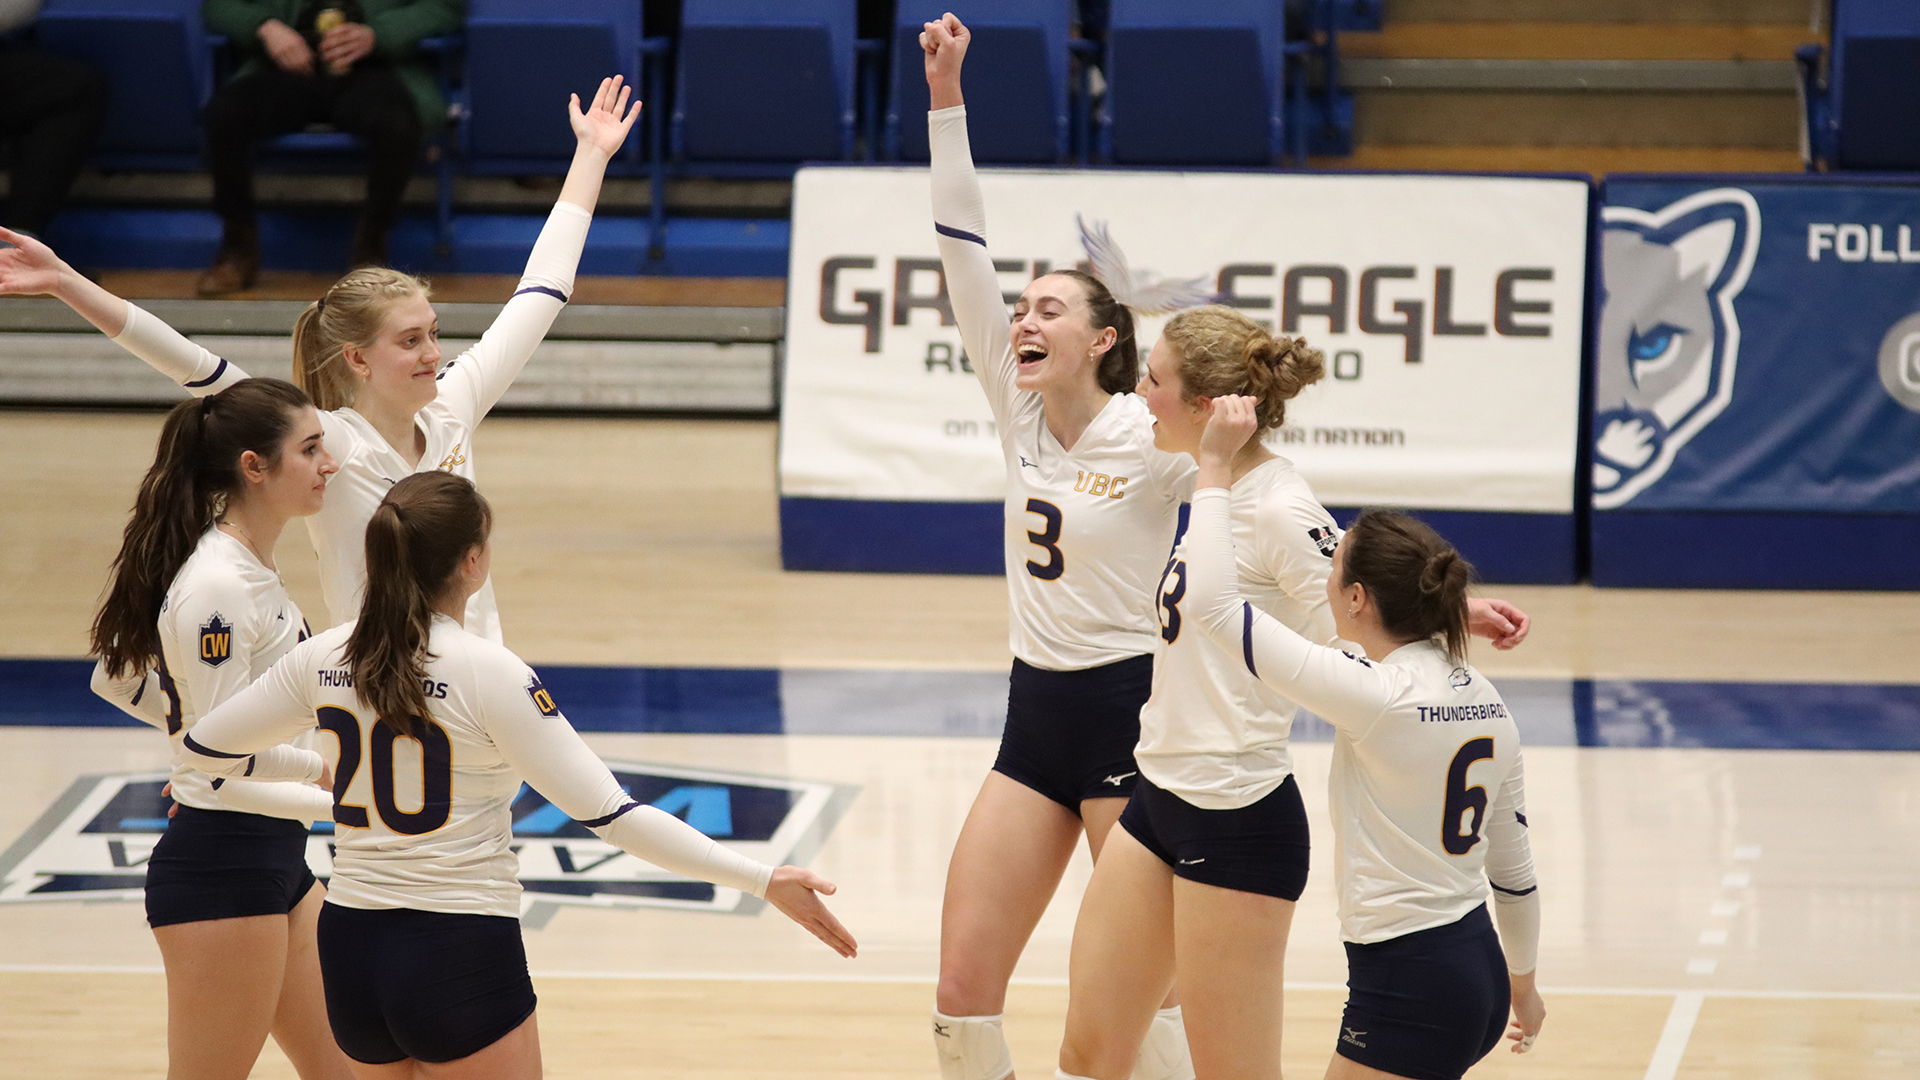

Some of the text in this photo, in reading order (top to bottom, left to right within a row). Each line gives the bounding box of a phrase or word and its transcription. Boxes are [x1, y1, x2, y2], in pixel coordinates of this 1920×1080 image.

[820, 256, 1555, 363] GR EAGLE
[1313, 429, 1405, 445] NATION
[1074, 470, 1128, 499] UBC
[1025, 497, 1065, 582] 3
[202, 633, 230, 658] CW
[1417, 703, 1507, 722] THUNDERBIRDS
[316, 704, 454, 837] 20
[1440, 735, 1495, 857] 6
